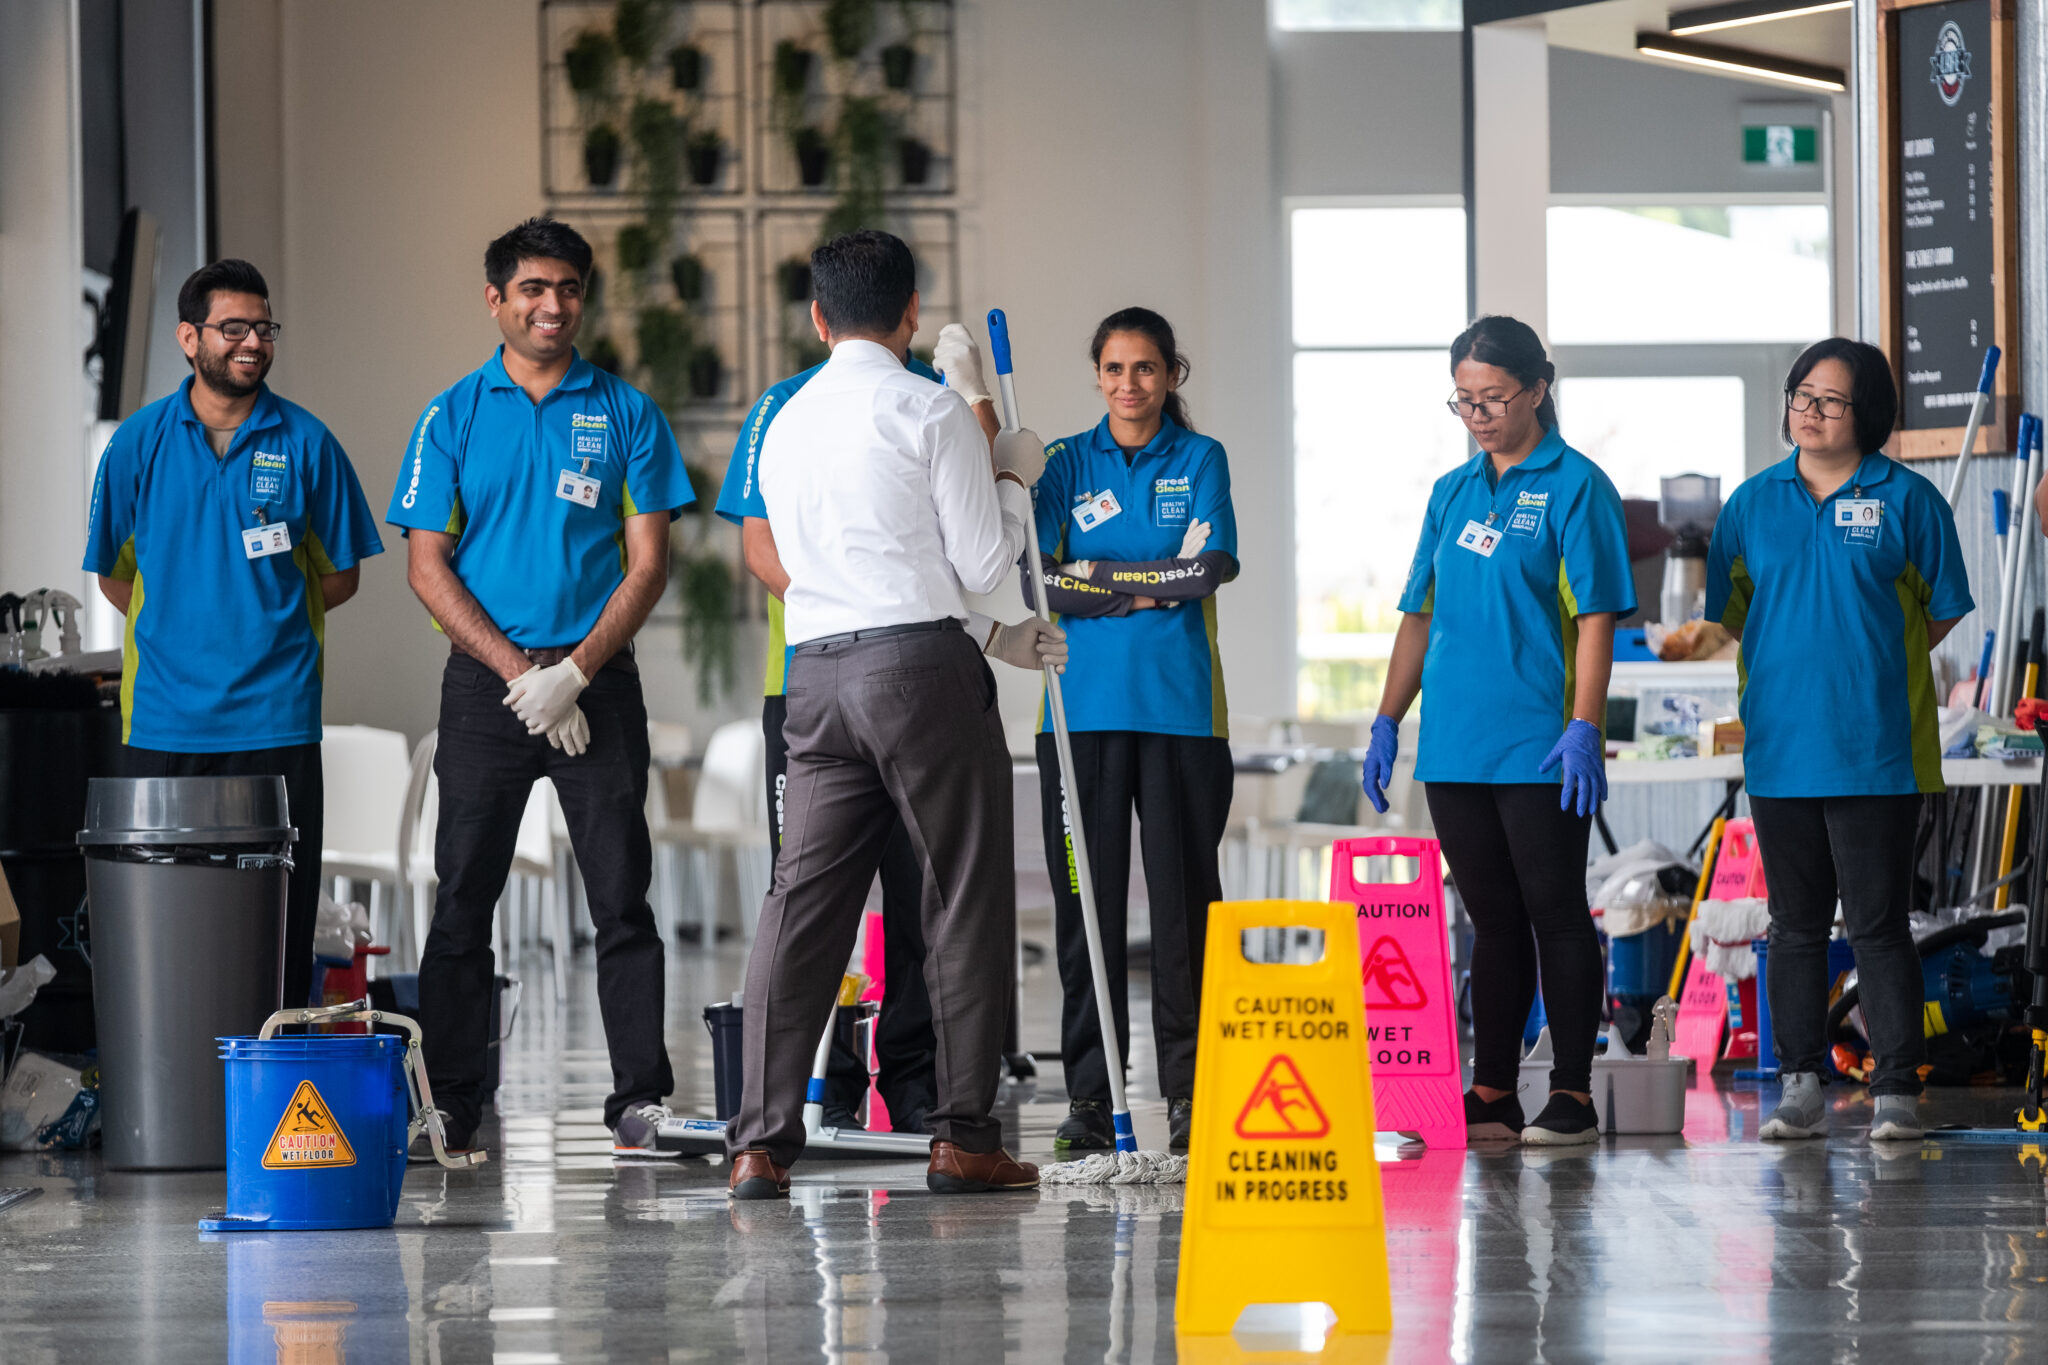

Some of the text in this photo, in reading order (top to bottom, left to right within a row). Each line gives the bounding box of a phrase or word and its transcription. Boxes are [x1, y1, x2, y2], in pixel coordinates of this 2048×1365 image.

[572, 413, 608, 422] Crest
[572, 420, 607, 429] Clean
[577, 441, 602, 449] CLEAN
[743, 395, 774, 499] CrestClean
[254, 451, 287, 462] Crest
[402, 405, 440, 509] CrestClean
[253, 459, 286, 469] Clean
[256, 481, 279, 490] CLEAN
[1155, 476, 1189, 486] Crest
[1155, 485, 1190, 493] Clean
[1519, 490, 1549, 501] Crest
[1517, 498, 1546, 507] Clean
[1513, 518, 1536, 527] CLEAN
[1851, 526, 1875, 535] CLEAN
[1113, 562, 1205, 584] CrestClean
[1357, 904, 1430, 918] AUTION
[1235, 997, 1334, 1015] CAUTION
[1220, 1021, 1349, 1039] WET FLOOR
[1369, 1050, 1431, 1064] OOR
[279, 1135, 336, 1149] CAUTION
[282, 1150, 334, 1161] WET FLOOR
[1229, 1151, 1337, 1171] CLEANING
[1217, 1180, 1349, 1201] IN PROGRESS
